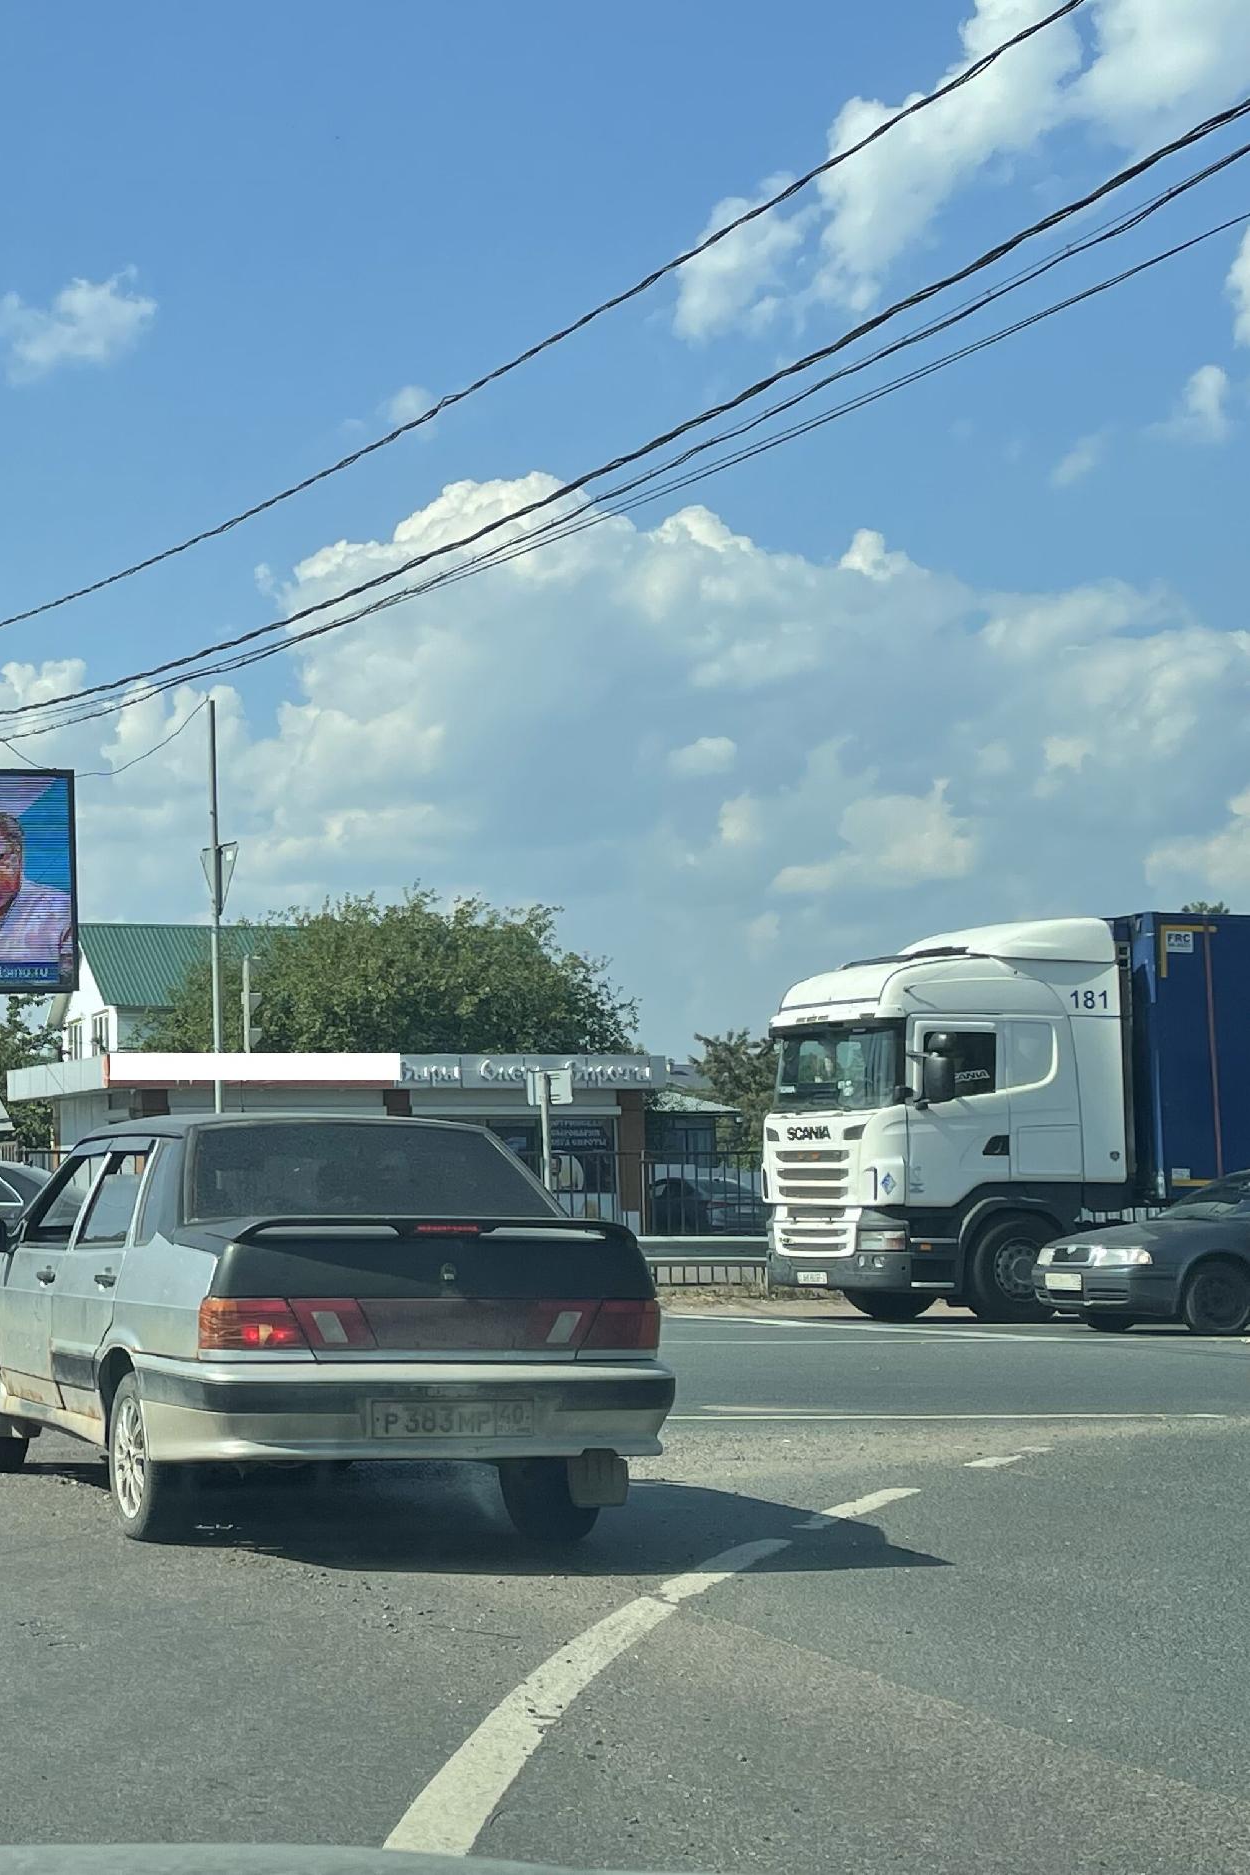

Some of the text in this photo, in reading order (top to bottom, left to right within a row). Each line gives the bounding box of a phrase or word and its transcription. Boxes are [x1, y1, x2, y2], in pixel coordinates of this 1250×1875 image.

[1070, 990, 1108, 1009] 181
[954, 1069, 991, 1082] CANIA
[786, 1126, 831, 1141] SCANIA
